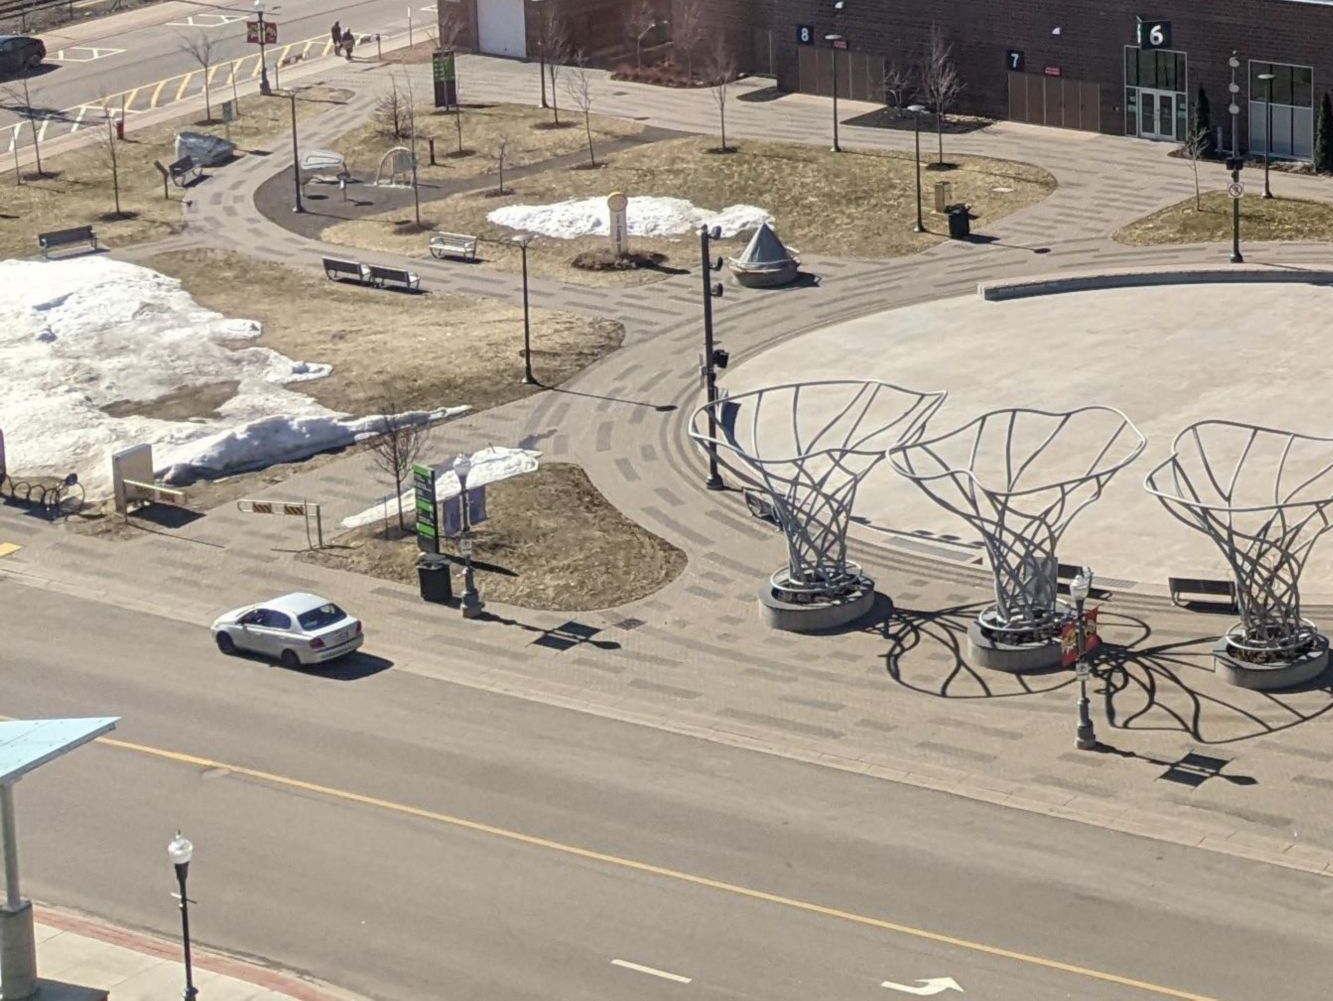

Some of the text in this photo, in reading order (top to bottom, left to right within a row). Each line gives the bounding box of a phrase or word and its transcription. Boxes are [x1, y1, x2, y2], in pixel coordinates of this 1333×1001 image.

[801, 27, 809, 42] 8
[1150, 24, 1164, 46] 6
[1010, 52, 1020, 69] 7
